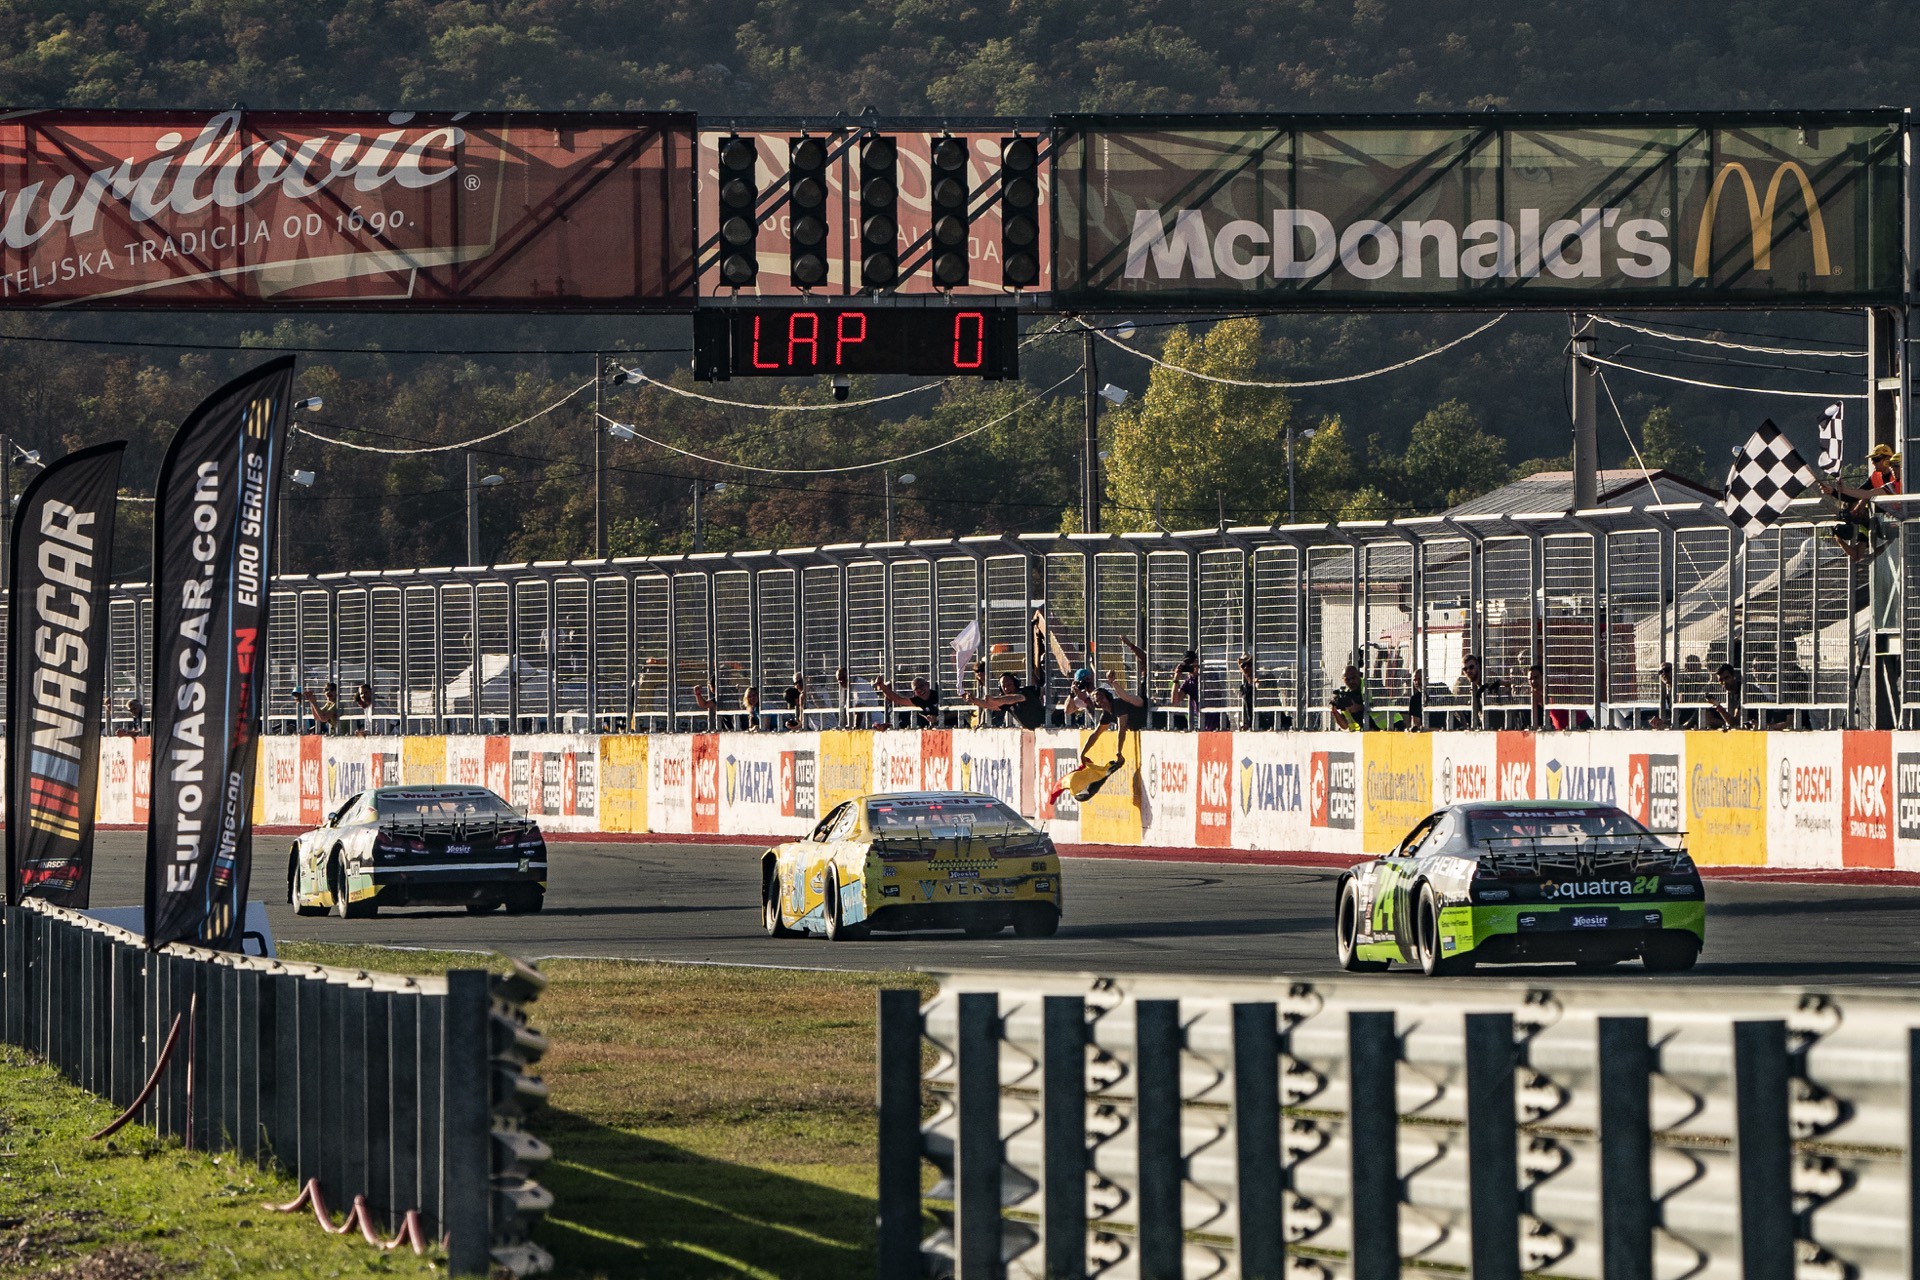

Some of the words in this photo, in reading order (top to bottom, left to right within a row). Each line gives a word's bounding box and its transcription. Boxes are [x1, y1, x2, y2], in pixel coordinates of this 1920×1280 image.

[0, 111, 471, 249] vrilović
[124, 219, 271, 266] TRADICIJA
[283, 213, 322, 239] OD
[336, 205, 415, 237] 1690.
[1124, 208, 1671, 279] McDonald's
[753, 312, 866, 368] LAP
[953, 312, 984, 368] 0
[241, 453, 263, 538] SERIES
[238, 544, 259, 607] EURO
[31, 499, 95, 760] NASCAR
[166, 461, 219, 892] EuroNASCAR.com
[277, 760, 294, 784] BOSCH
[302, 759, 319, 796] NGK
[338, 762, 366, 800] VARTA
[664, 758, 685, 786] BOSCH
[695, 759, 716, 800] NGK
[738, 760, 775, 804] VARTA
[795, 759, 814, 785] INTER
[891, 756, 915, 786] BOSCH
[925, 756, 949, 791] NGK
[974, 757, 1014, 803] VARTA
[1161, 761, 1188, 793] BOSCH
[1201, 760, 1228, 806] NGK
[1256, 763, 1302, 812] VARTA
[1331, 762, 1355, 789] INTER
[1367, 760, 1419, 812] Continental
[1456, 764, 1487, 799] BOSCH
[1501, 762, 1531, 801] NGK
[1566, 765, 1617, 807] VARTA
[1651, 765, 1678, 794] INTER
[1795, 766, 1832, 803] BOSCH
[401, 791, 464, 799] WHELEN
[897, 798, 970, 806] WHELEN
[1331, 793, 1355, 819] CARS
[1691, 763, 1753, 819] Continental
[1850, 764, 1887, 818] NGK
[1502, 810, 1586, 818] WHELEN
[1651, 798, 1678, 829] CARS
[1850, 820, 1867, 838] SPARK
[1573, 915, 1608, 926] Hoosier
